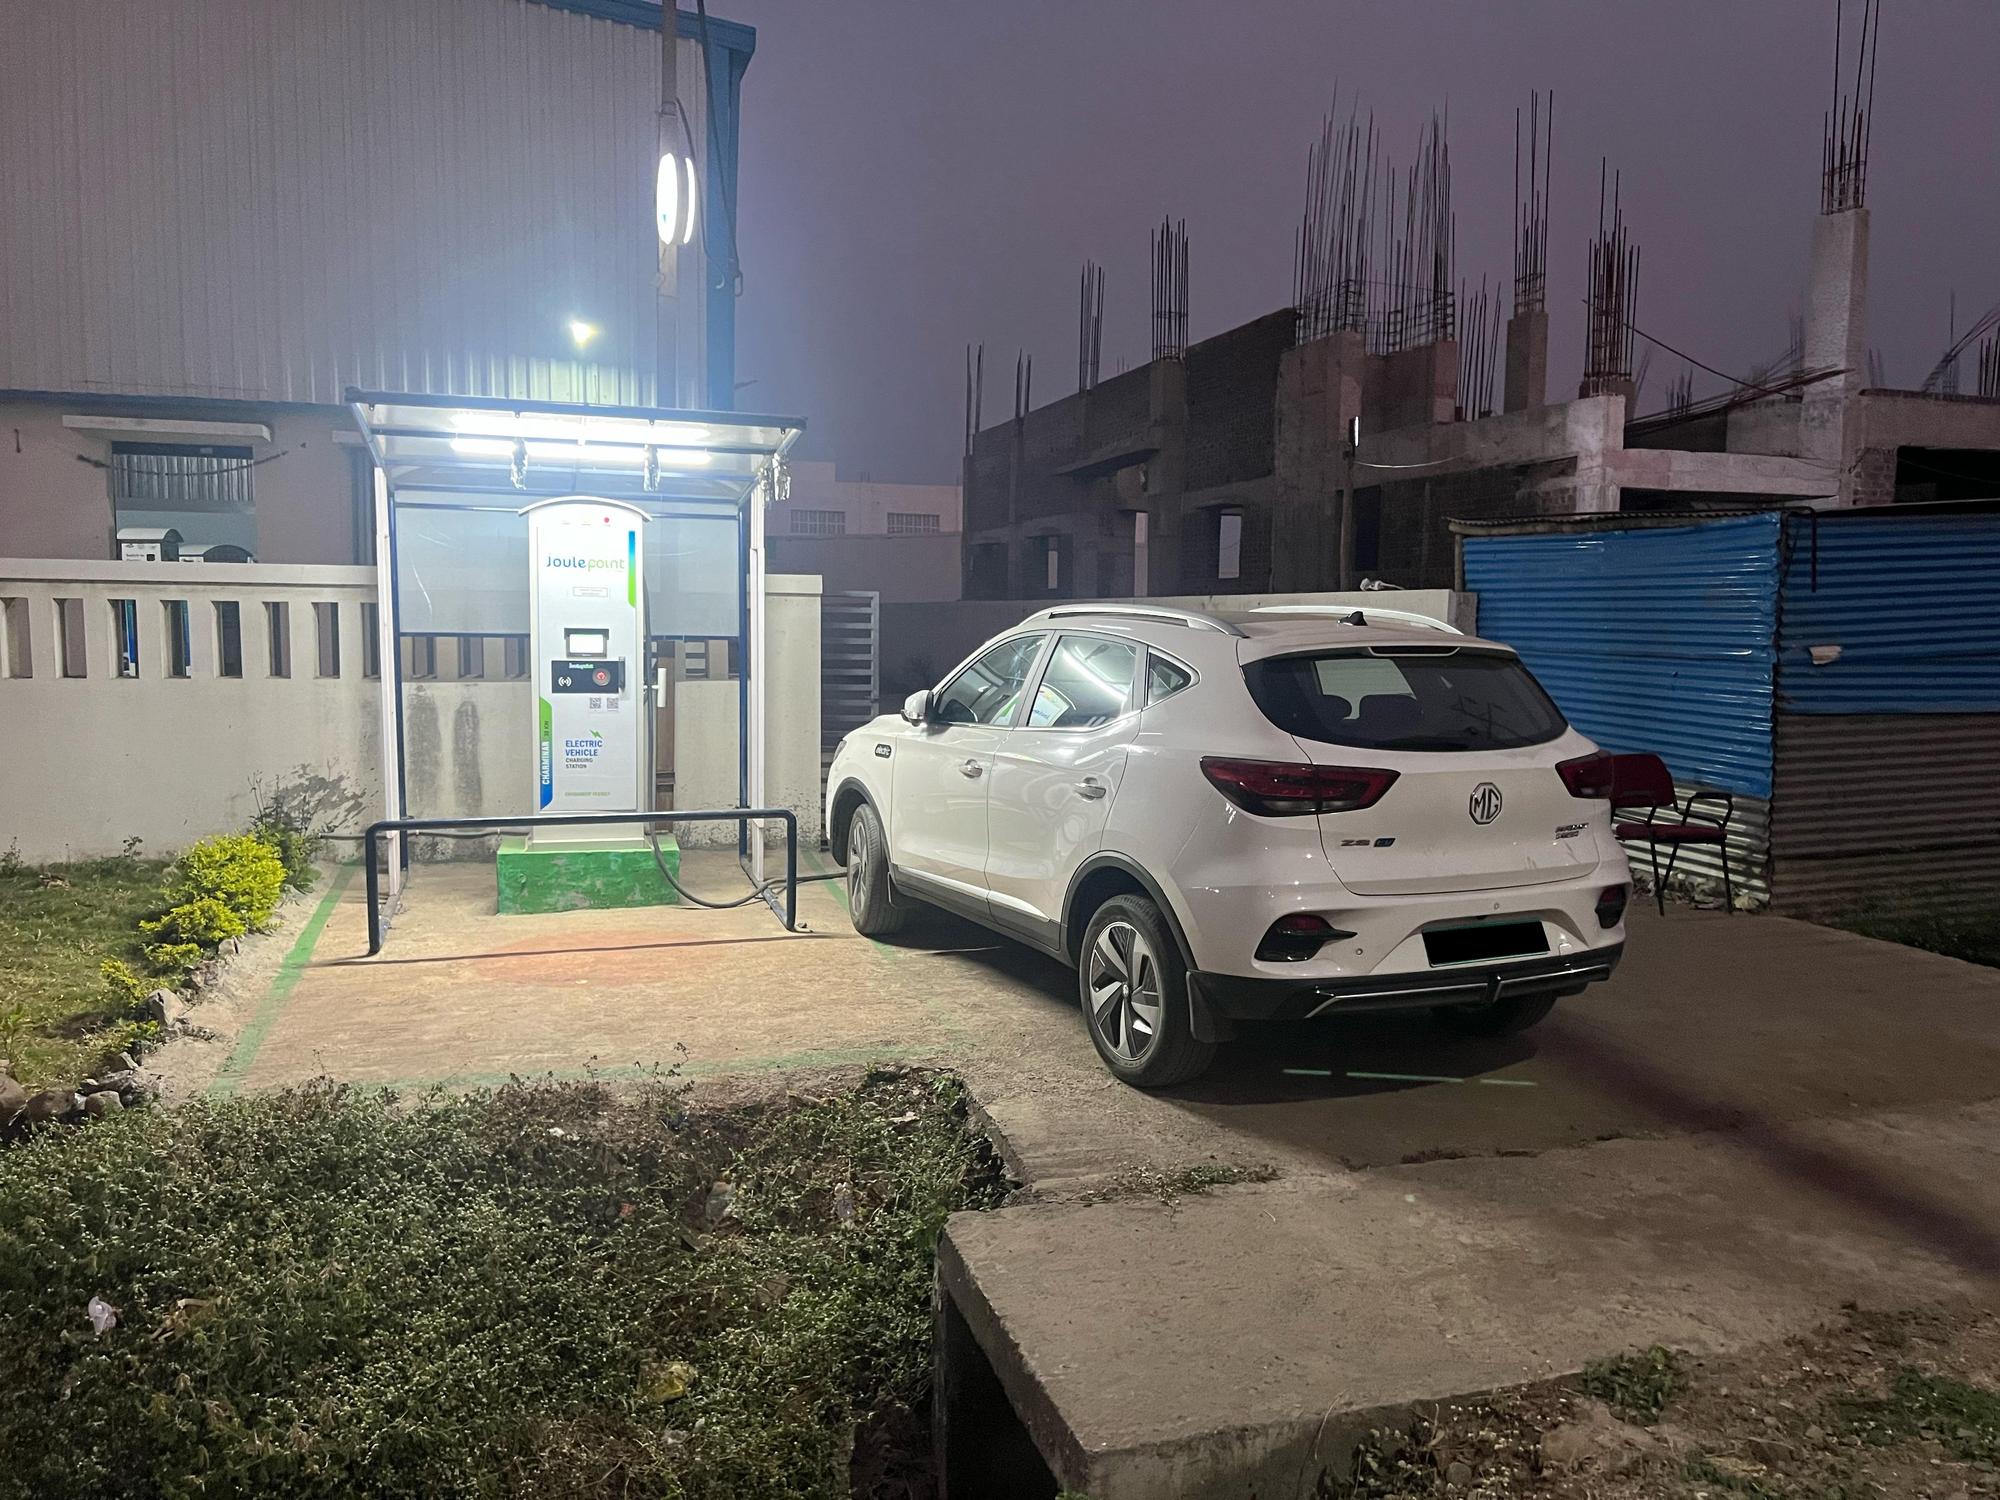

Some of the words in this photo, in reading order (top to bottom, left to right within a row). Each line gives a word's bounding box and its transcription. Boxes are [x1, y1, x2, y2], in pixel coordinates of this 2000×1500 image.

[565, 740, 603, 748] ELECTRIC
[565, 749, 599, 757] VEHICLE
[541, 741, 550, 785] CHARMINAR
[1473, 786, 1500, 821] MG
